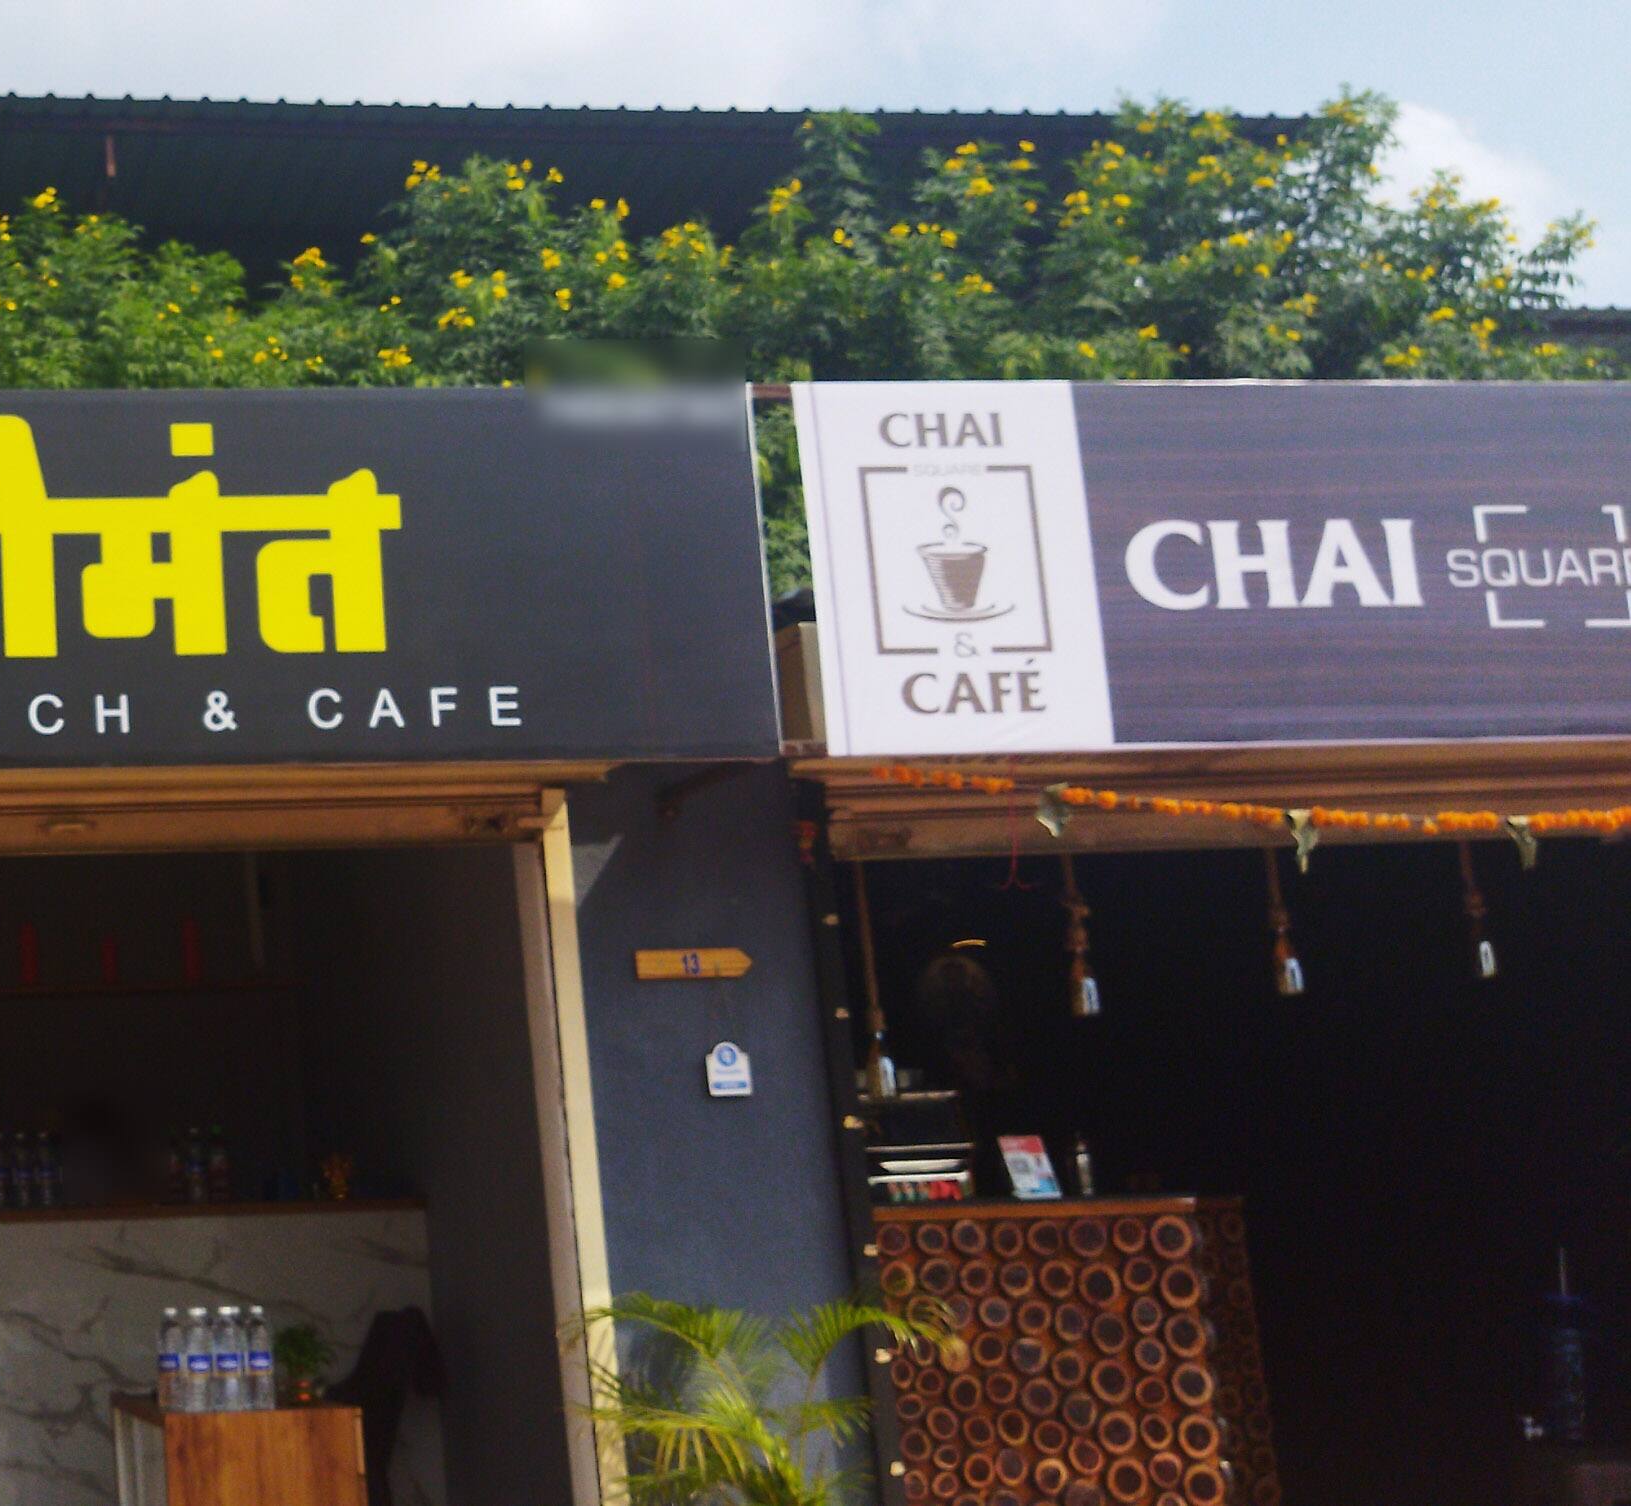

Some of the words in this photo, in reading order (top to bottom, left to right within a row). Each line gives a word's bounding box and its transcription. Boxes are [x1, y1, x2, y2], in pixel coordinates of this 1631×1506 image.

[880, 412, 1002, 447] CHAI
[1125, 517, 1424, 612] CHAI
[953, 632, 979, 658] &
[202, 690, 239, 731] &
[307, 686, 522, 730] CAFE
[901, 658, 1046, 714] CAFÉ
